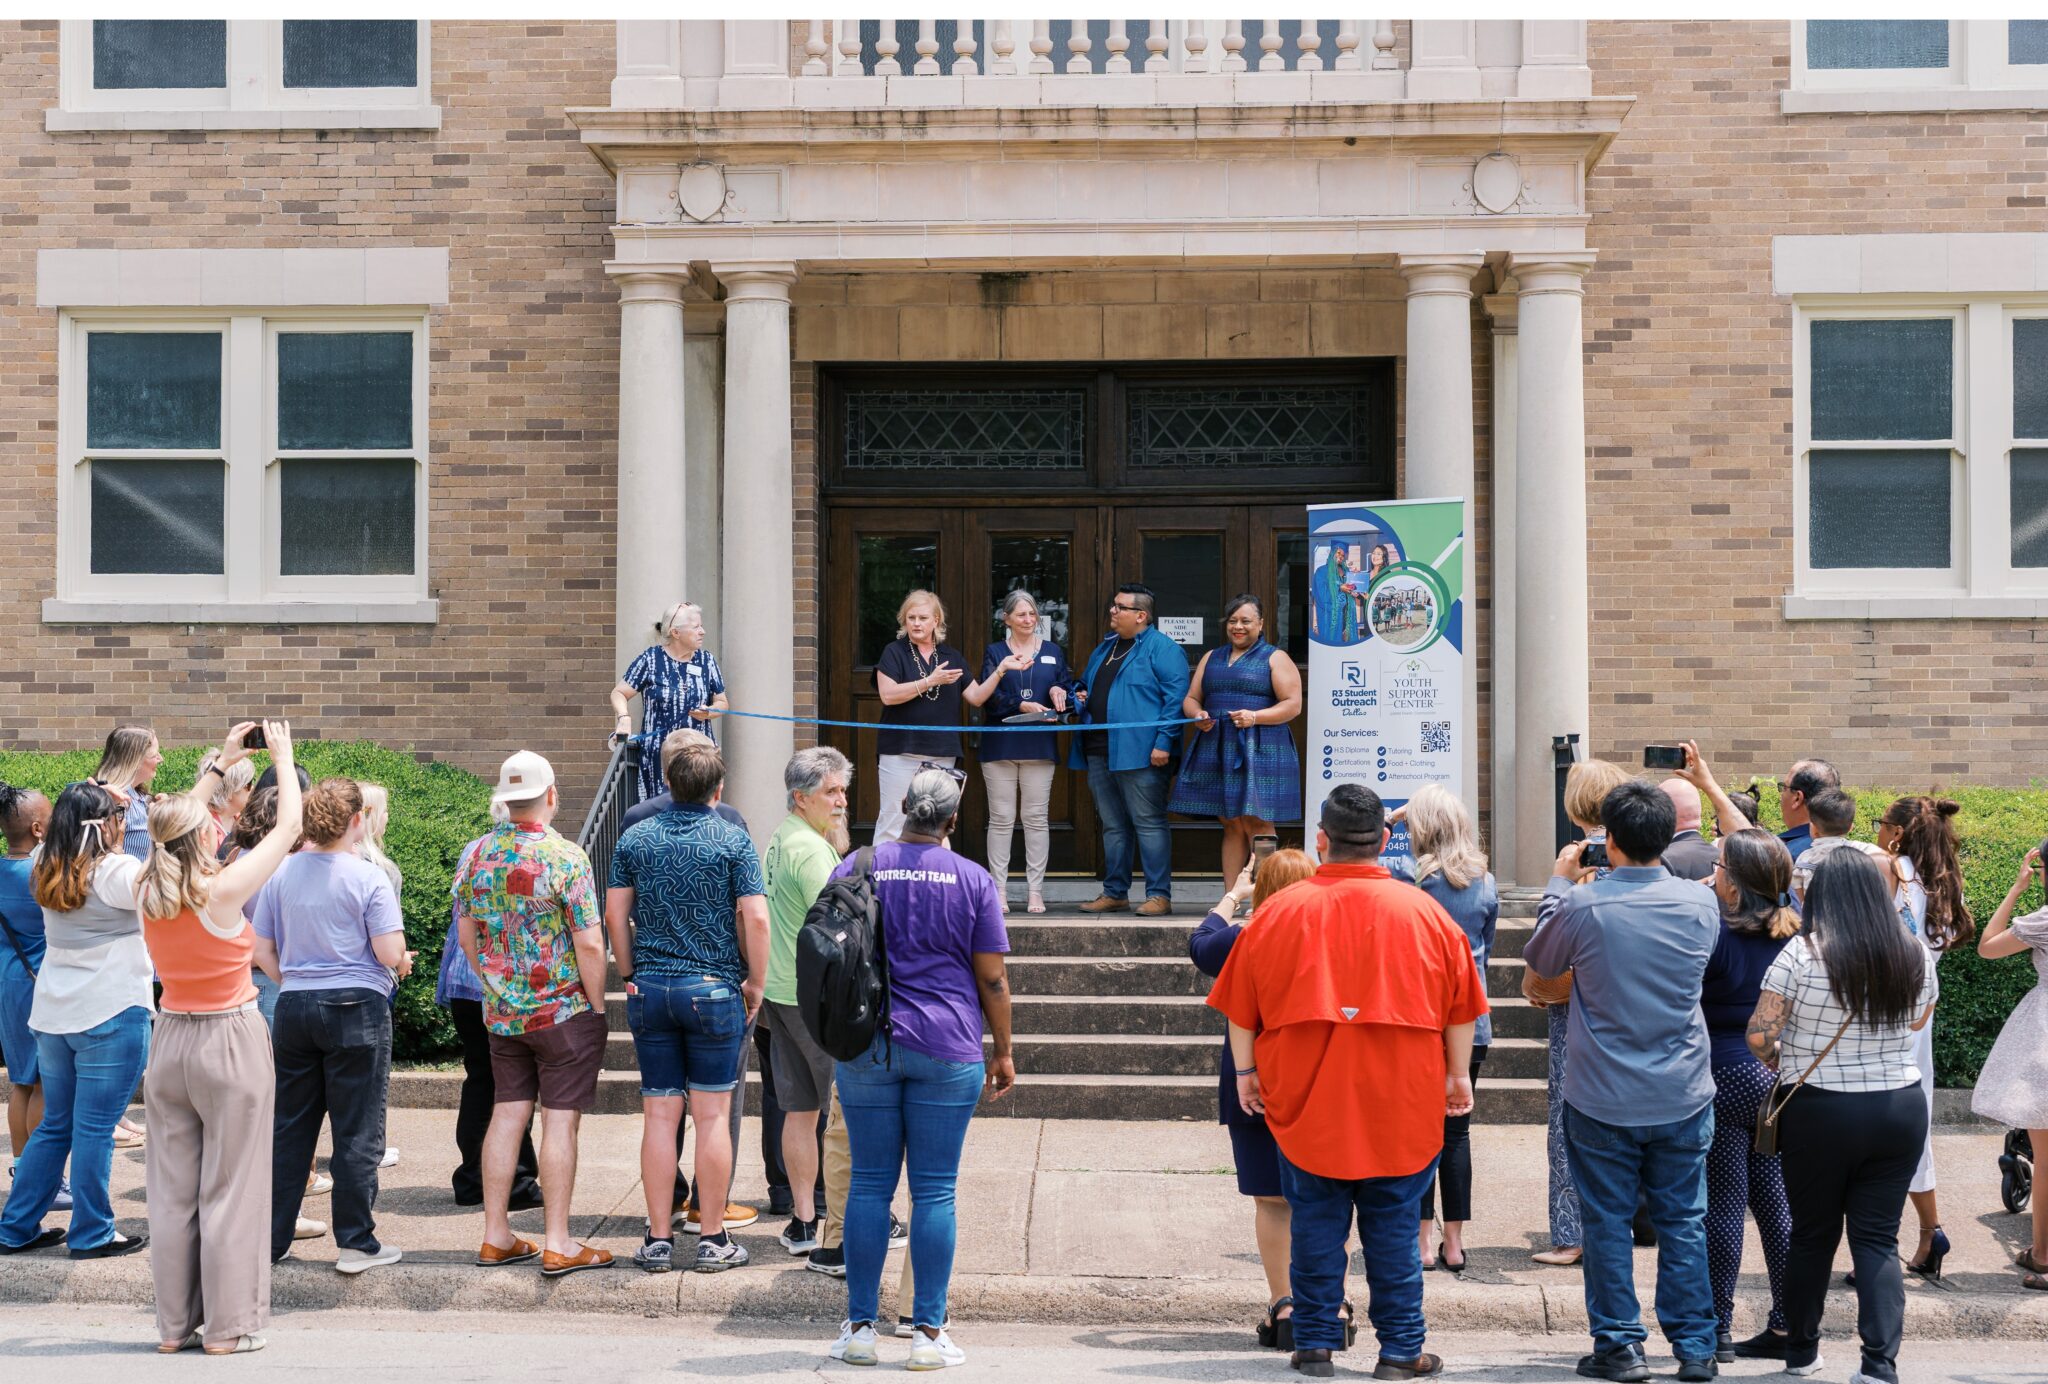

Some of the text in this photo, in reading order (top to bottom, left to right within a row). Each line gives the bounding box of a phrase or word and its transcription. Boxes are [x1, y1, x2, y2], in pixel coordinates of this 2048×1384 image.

[1394, 678, 1432, 687] YOUTH
[1344, 689, 1377, 697] Student
[1388, 689, 1438, 699] SUPPORT
[1332, 697, 1377, 707] Outreach
[1393, 699, 1434, 708] CENTER
[1342, 708, 1367, 716] Dallas
[1323, 729, 1379, 737] Our Services:
[1410, 760, 1436, 768] Clothing
[1424, 773, 1450, 781] Program
[874, 869, 957, 884] OUTREACH TEAM
